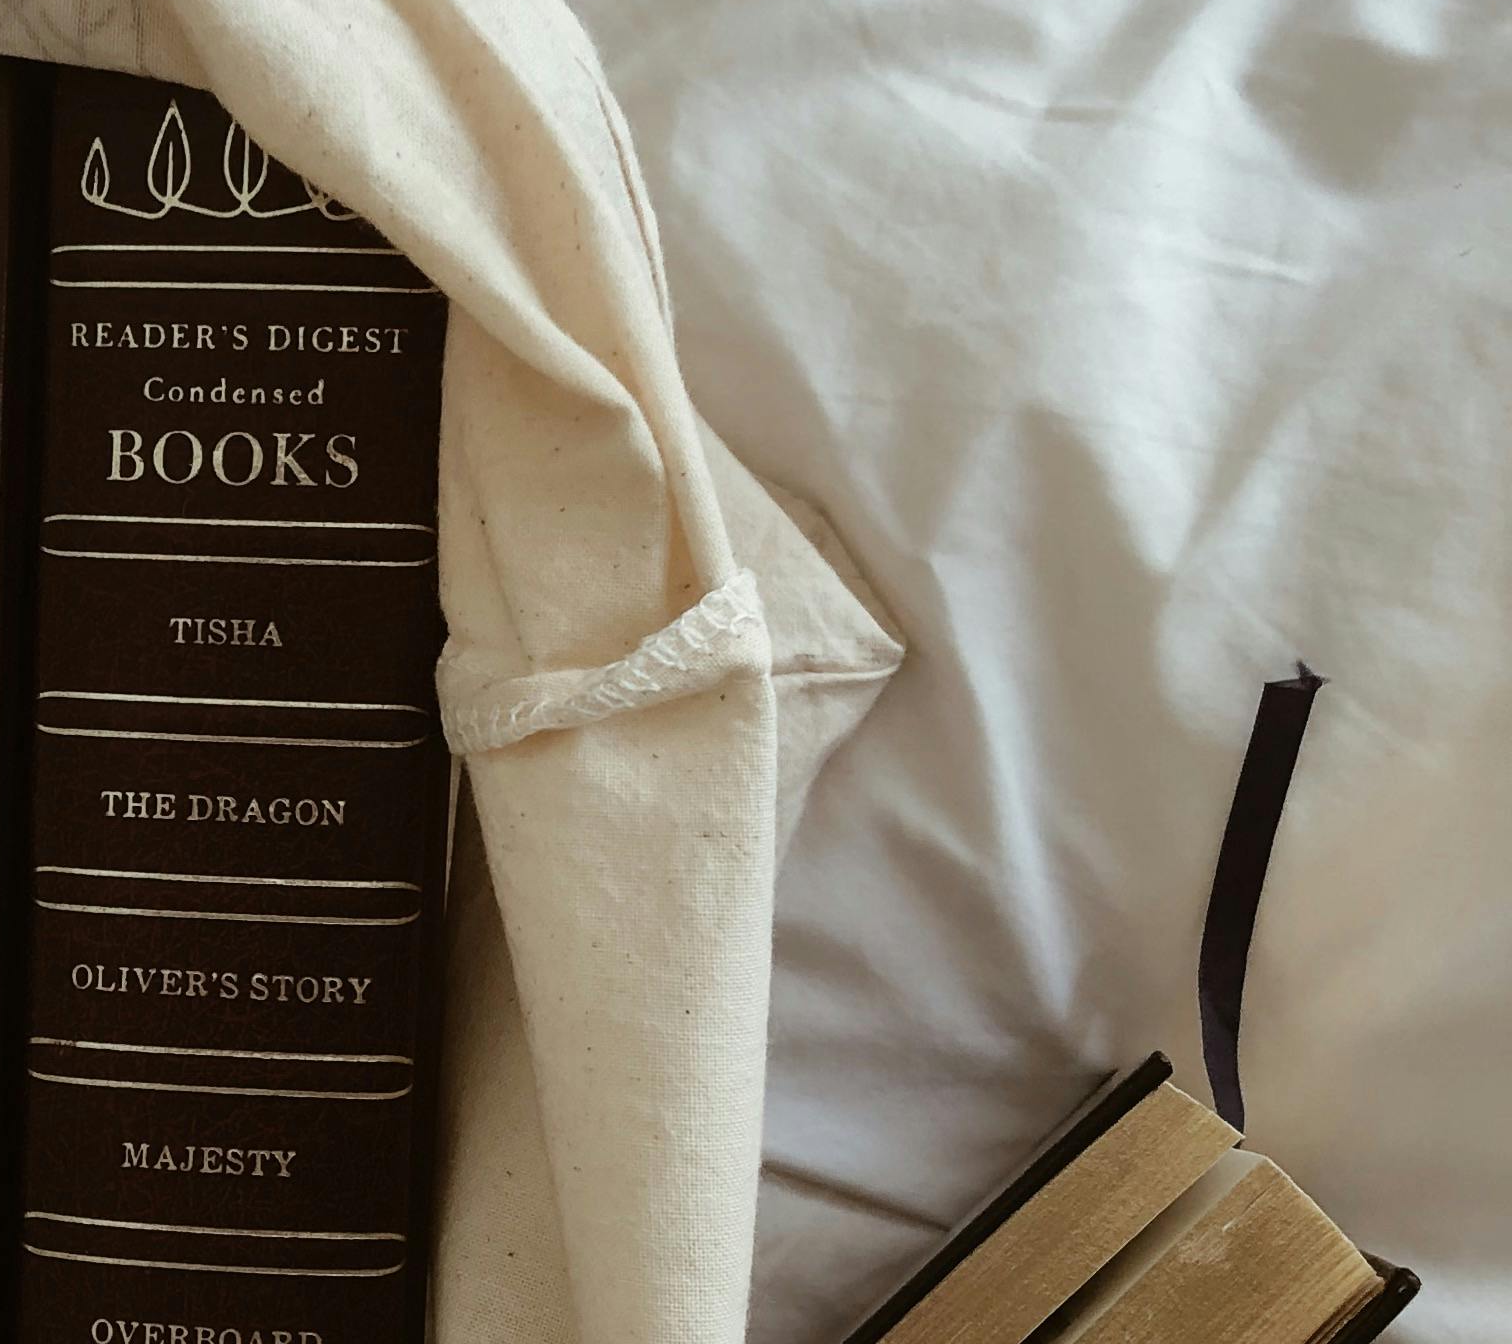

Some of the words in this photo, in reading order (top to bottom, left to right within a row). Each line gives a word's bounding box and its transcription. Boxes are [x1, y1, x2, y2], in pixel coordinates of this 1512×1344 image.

[72, 323, 248, 350] READER'S
[268, 325, 409, 353] DIGEST
[144, 377, 324, 405] Condensed
[107, 430, 358, 487] BOOKS
[170, 618, 282, 646] TISHA
[101, 791, 175, 819] THE
[187, 795, 345, 825] DRAGON
[72, 964, 238, 998] OLIVER'S
[250, 973, 371, 1004] STORY
[122, 1143, 296, 1177] MAJESTY
